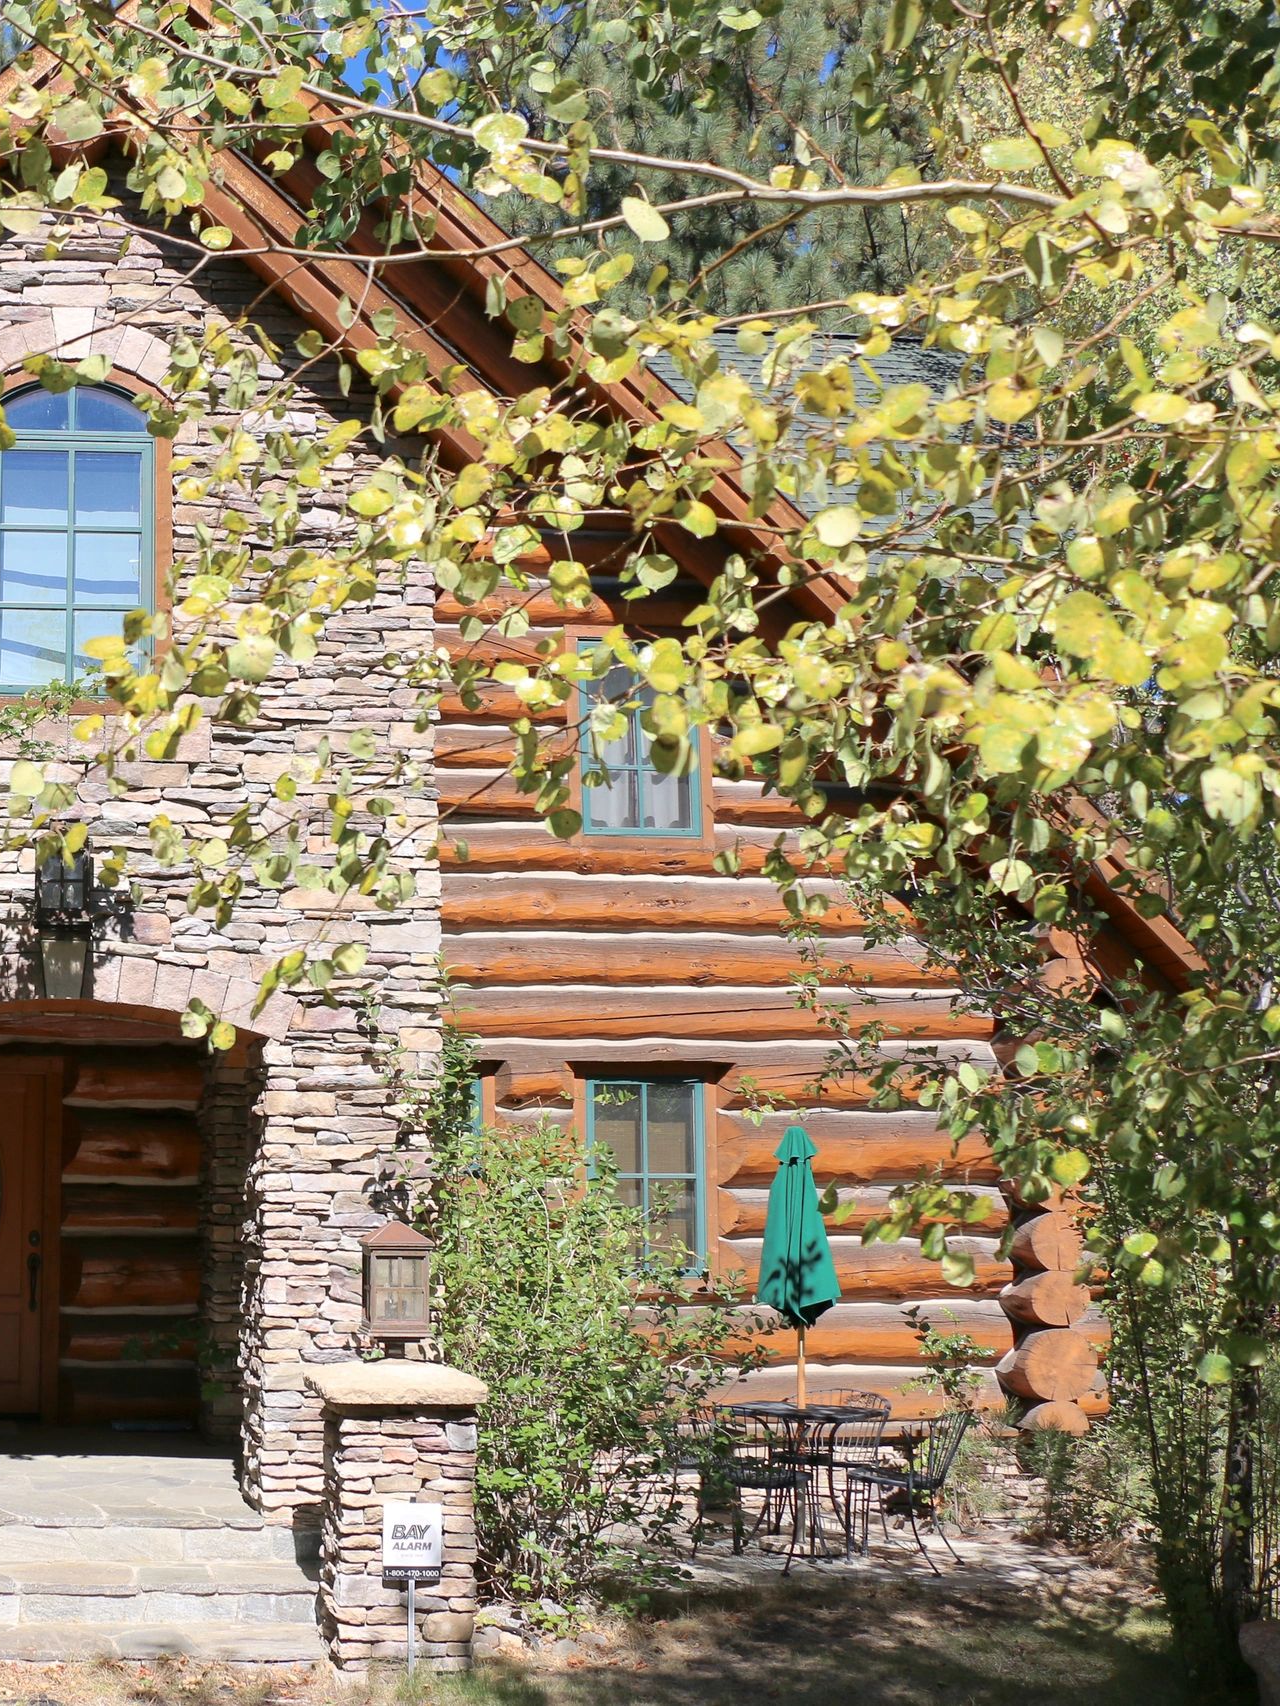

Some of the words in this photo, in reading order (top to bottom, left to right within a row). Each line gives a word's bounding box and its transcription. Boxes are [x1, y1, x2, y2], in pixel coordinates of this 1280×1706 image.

[391, 1524, 431, 1540] BAY
[392, 1542, 432, 1551] ALARM
[385, 1569, 439, 1577] 1-800-470-1000
